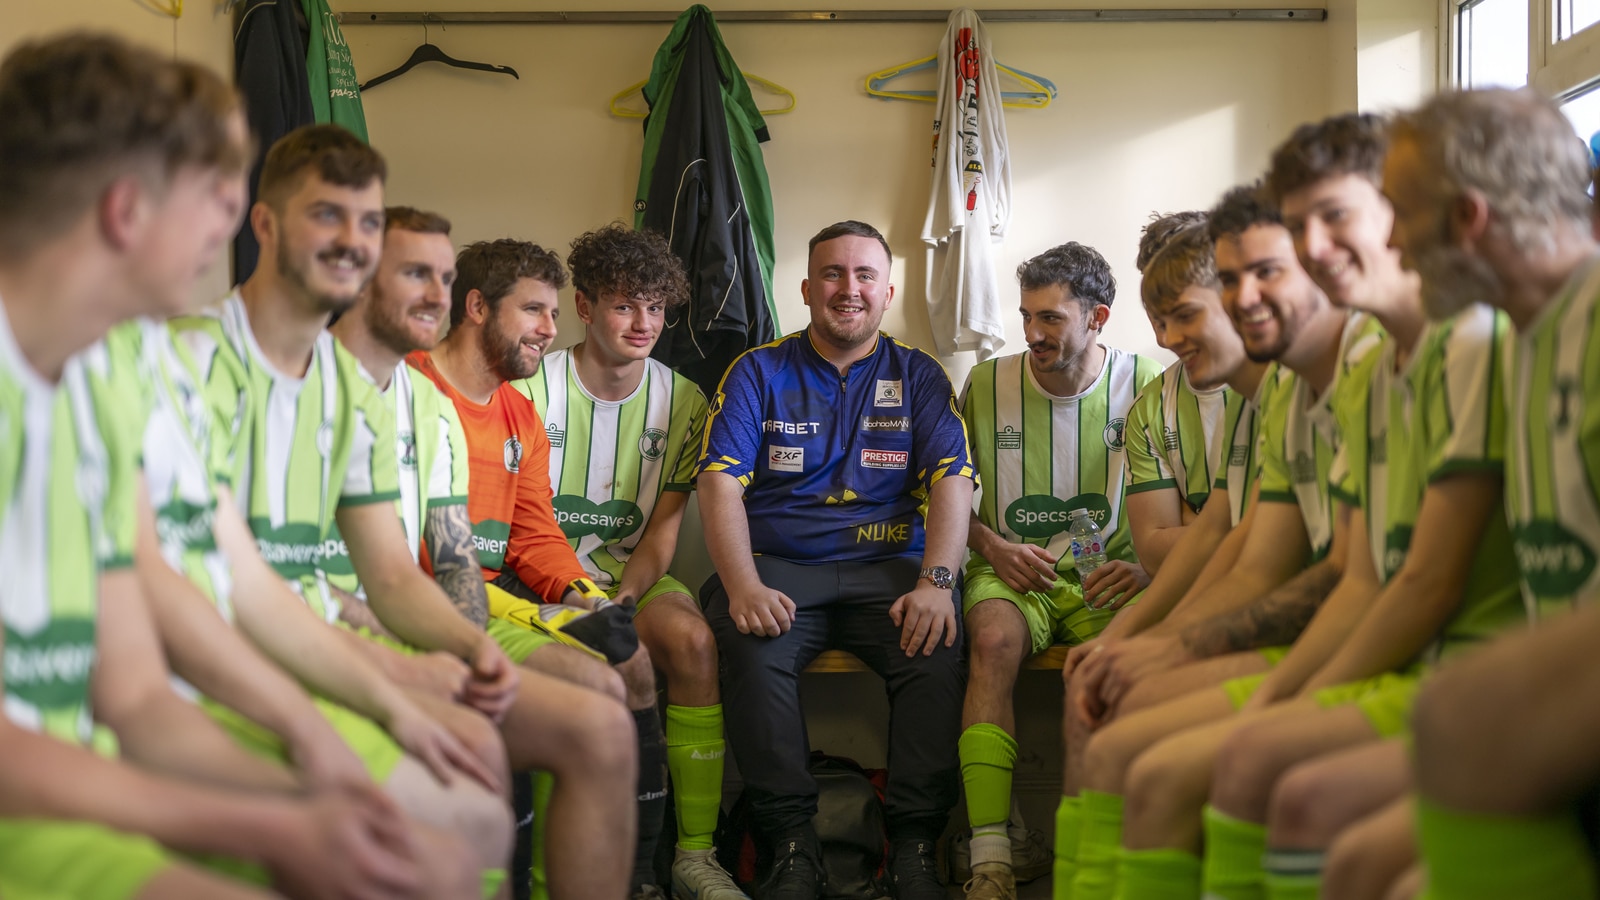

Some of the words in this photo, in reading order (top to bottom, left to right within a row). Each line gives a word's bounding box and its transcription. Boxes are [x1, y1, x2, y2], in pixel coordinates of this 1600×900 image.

[863, 451, 907, 462] PRESTIGE
[1015, 508, 1106, 526] Specsaers
[856, 523, 910, 544] NUKE
